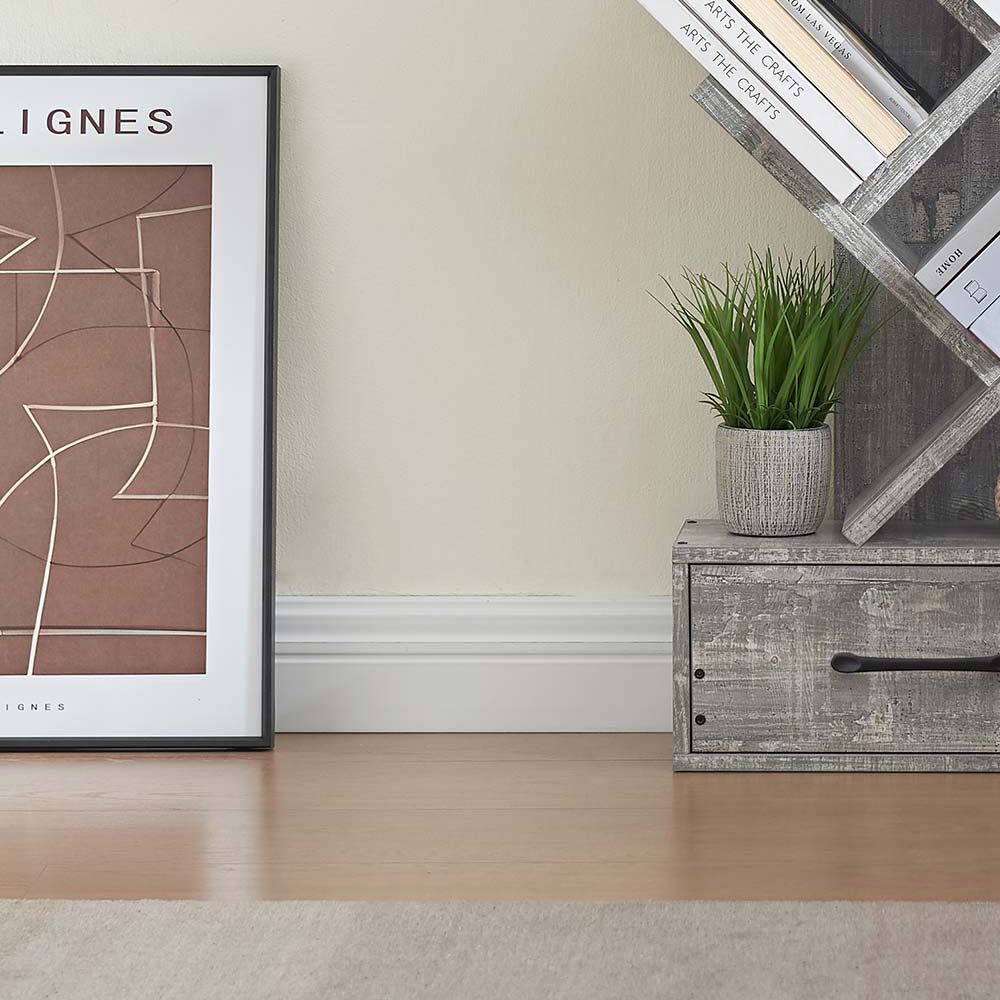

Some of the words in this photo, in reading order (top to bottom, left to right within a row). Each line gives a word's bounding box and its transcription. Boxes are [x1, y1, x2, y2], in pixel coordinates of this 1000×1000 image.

[702, 0, 738, 31] ARTS
[735, 26, 763, 57] THE
[760, 53, 806, 99] CRAFTS
[803, 11, 823, 33] LAS
[822, 29, 853, 62] VEGAS
[678, 22, 713, 54] ARTS
[710, 49, 739, 80] THE
[735, 76, 782, 122] CRAFTS
[0, 108, 174, 135] IGNES
[935, 248, 964, 277] HOME
[5, 703, 65, 711] IGNES
